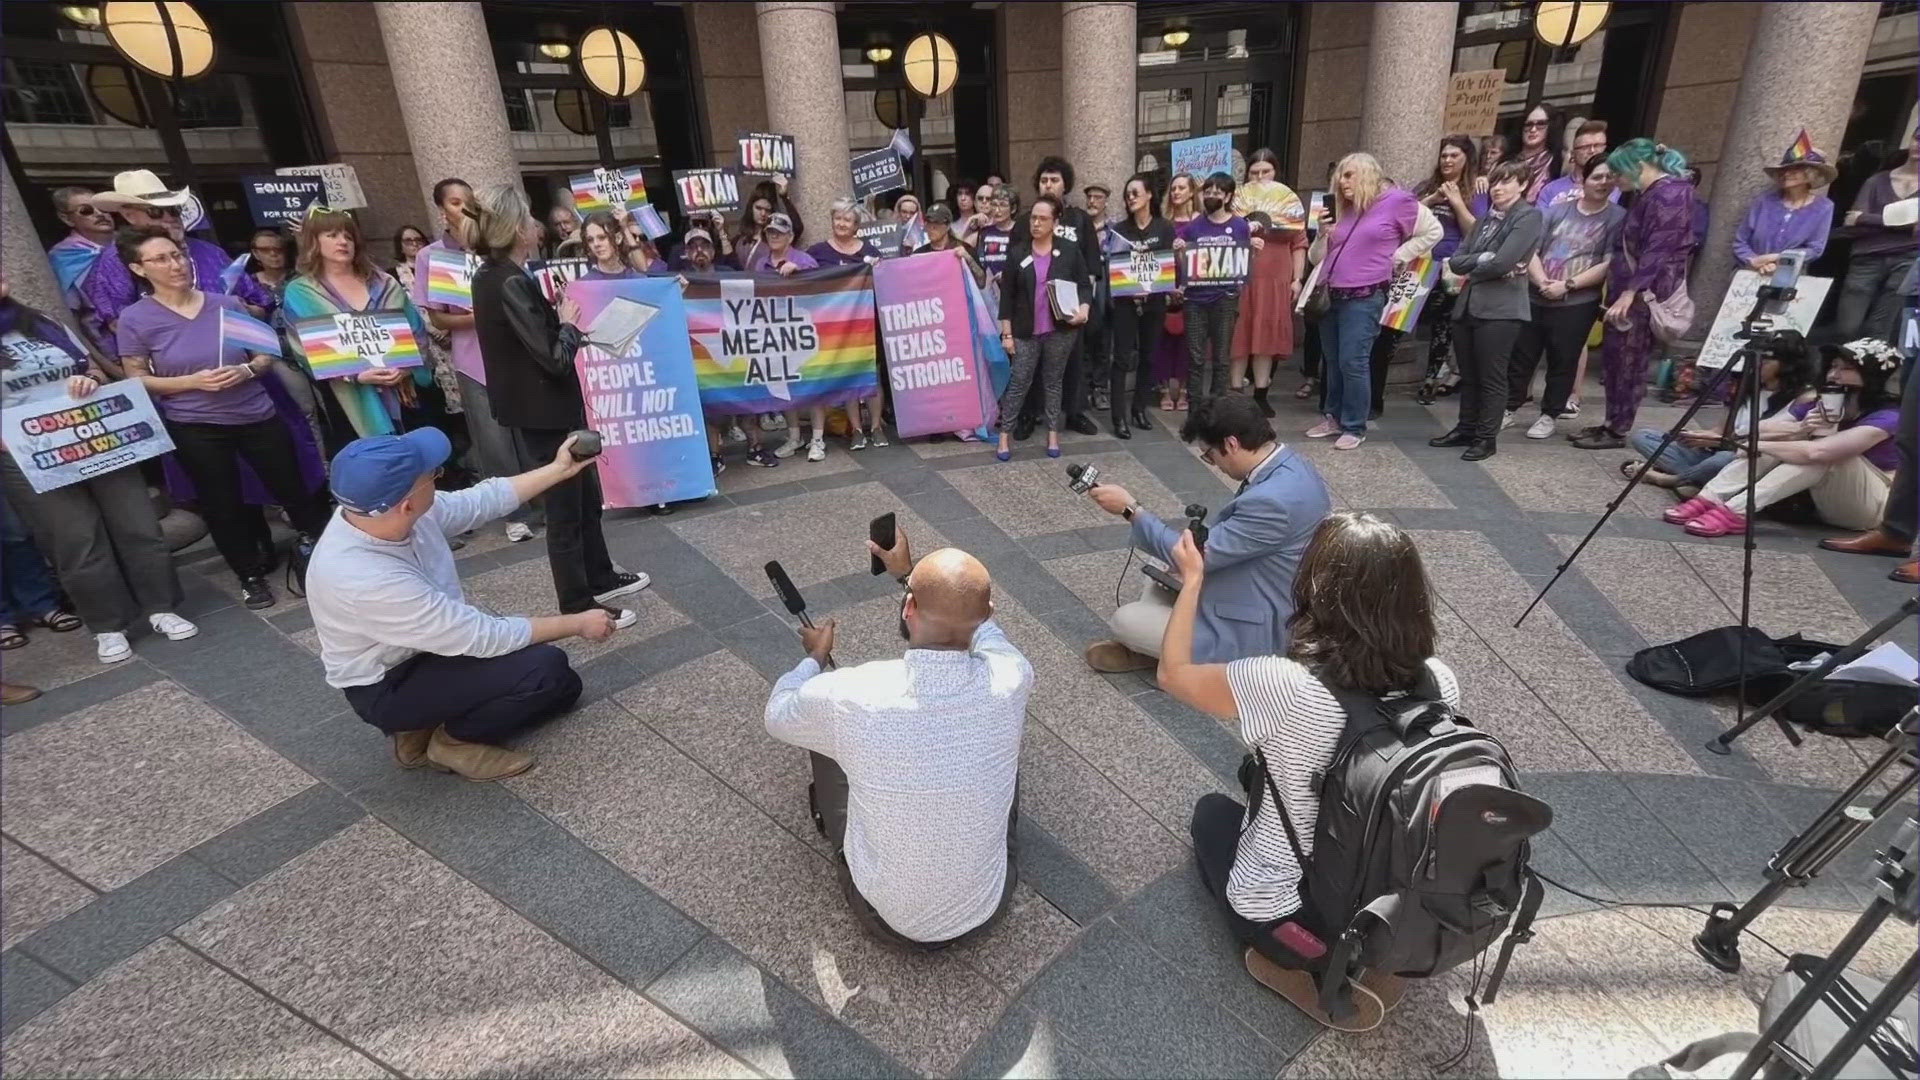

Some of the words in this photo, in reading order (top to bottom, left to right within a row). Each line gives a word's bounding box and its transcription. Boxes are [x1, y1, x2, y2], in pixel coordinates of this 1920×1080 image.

[1479, 75, 1498, 89] the
[739, 138, 794, 170] TEXAN
[597, 169, 625, 183] Y'ALL
[854, 163, 897, 184] ERASED
[253, 182, 319, 194] EQUALITY
[597, 180, 630, 195] MEANS
[608, 192, 627, 204] ALL
[677, 173, 739, 207] TEXAN
[284, 197, 302, 209] IS
[1130, 263, 1160, 273] MEANS
[1185, 247, 1250, 278] TEXAN
[1137, 273, 1154, 282] ALL
[339, 316, 381, 331] Y'ALL
[726, 297, 804, 325] Y'ALL
[881, 297, 945, 331] TRANS
[340, 329, 390, 346] MEANS
[357, 343, 387, 357] ALL
[722, 325, 816, 356] MEANS
[885, 329, 947, 361] TEXAS
[5, 364, 80, 392] NETWOR
[585, 361, 656, 390] PEOPLE
[747, 355, 800, 383] ALL
[892, 357, 971, 391] STRONG.
[591, 393, 636, 419] WILL
[642, 387, 677, 415] NOT
[23, 408, 86, 435] COME
[76, 421, 106, 440] OR
[596, 422, 622, 447] BE
[624, 414, 700, 444] ERASED.
